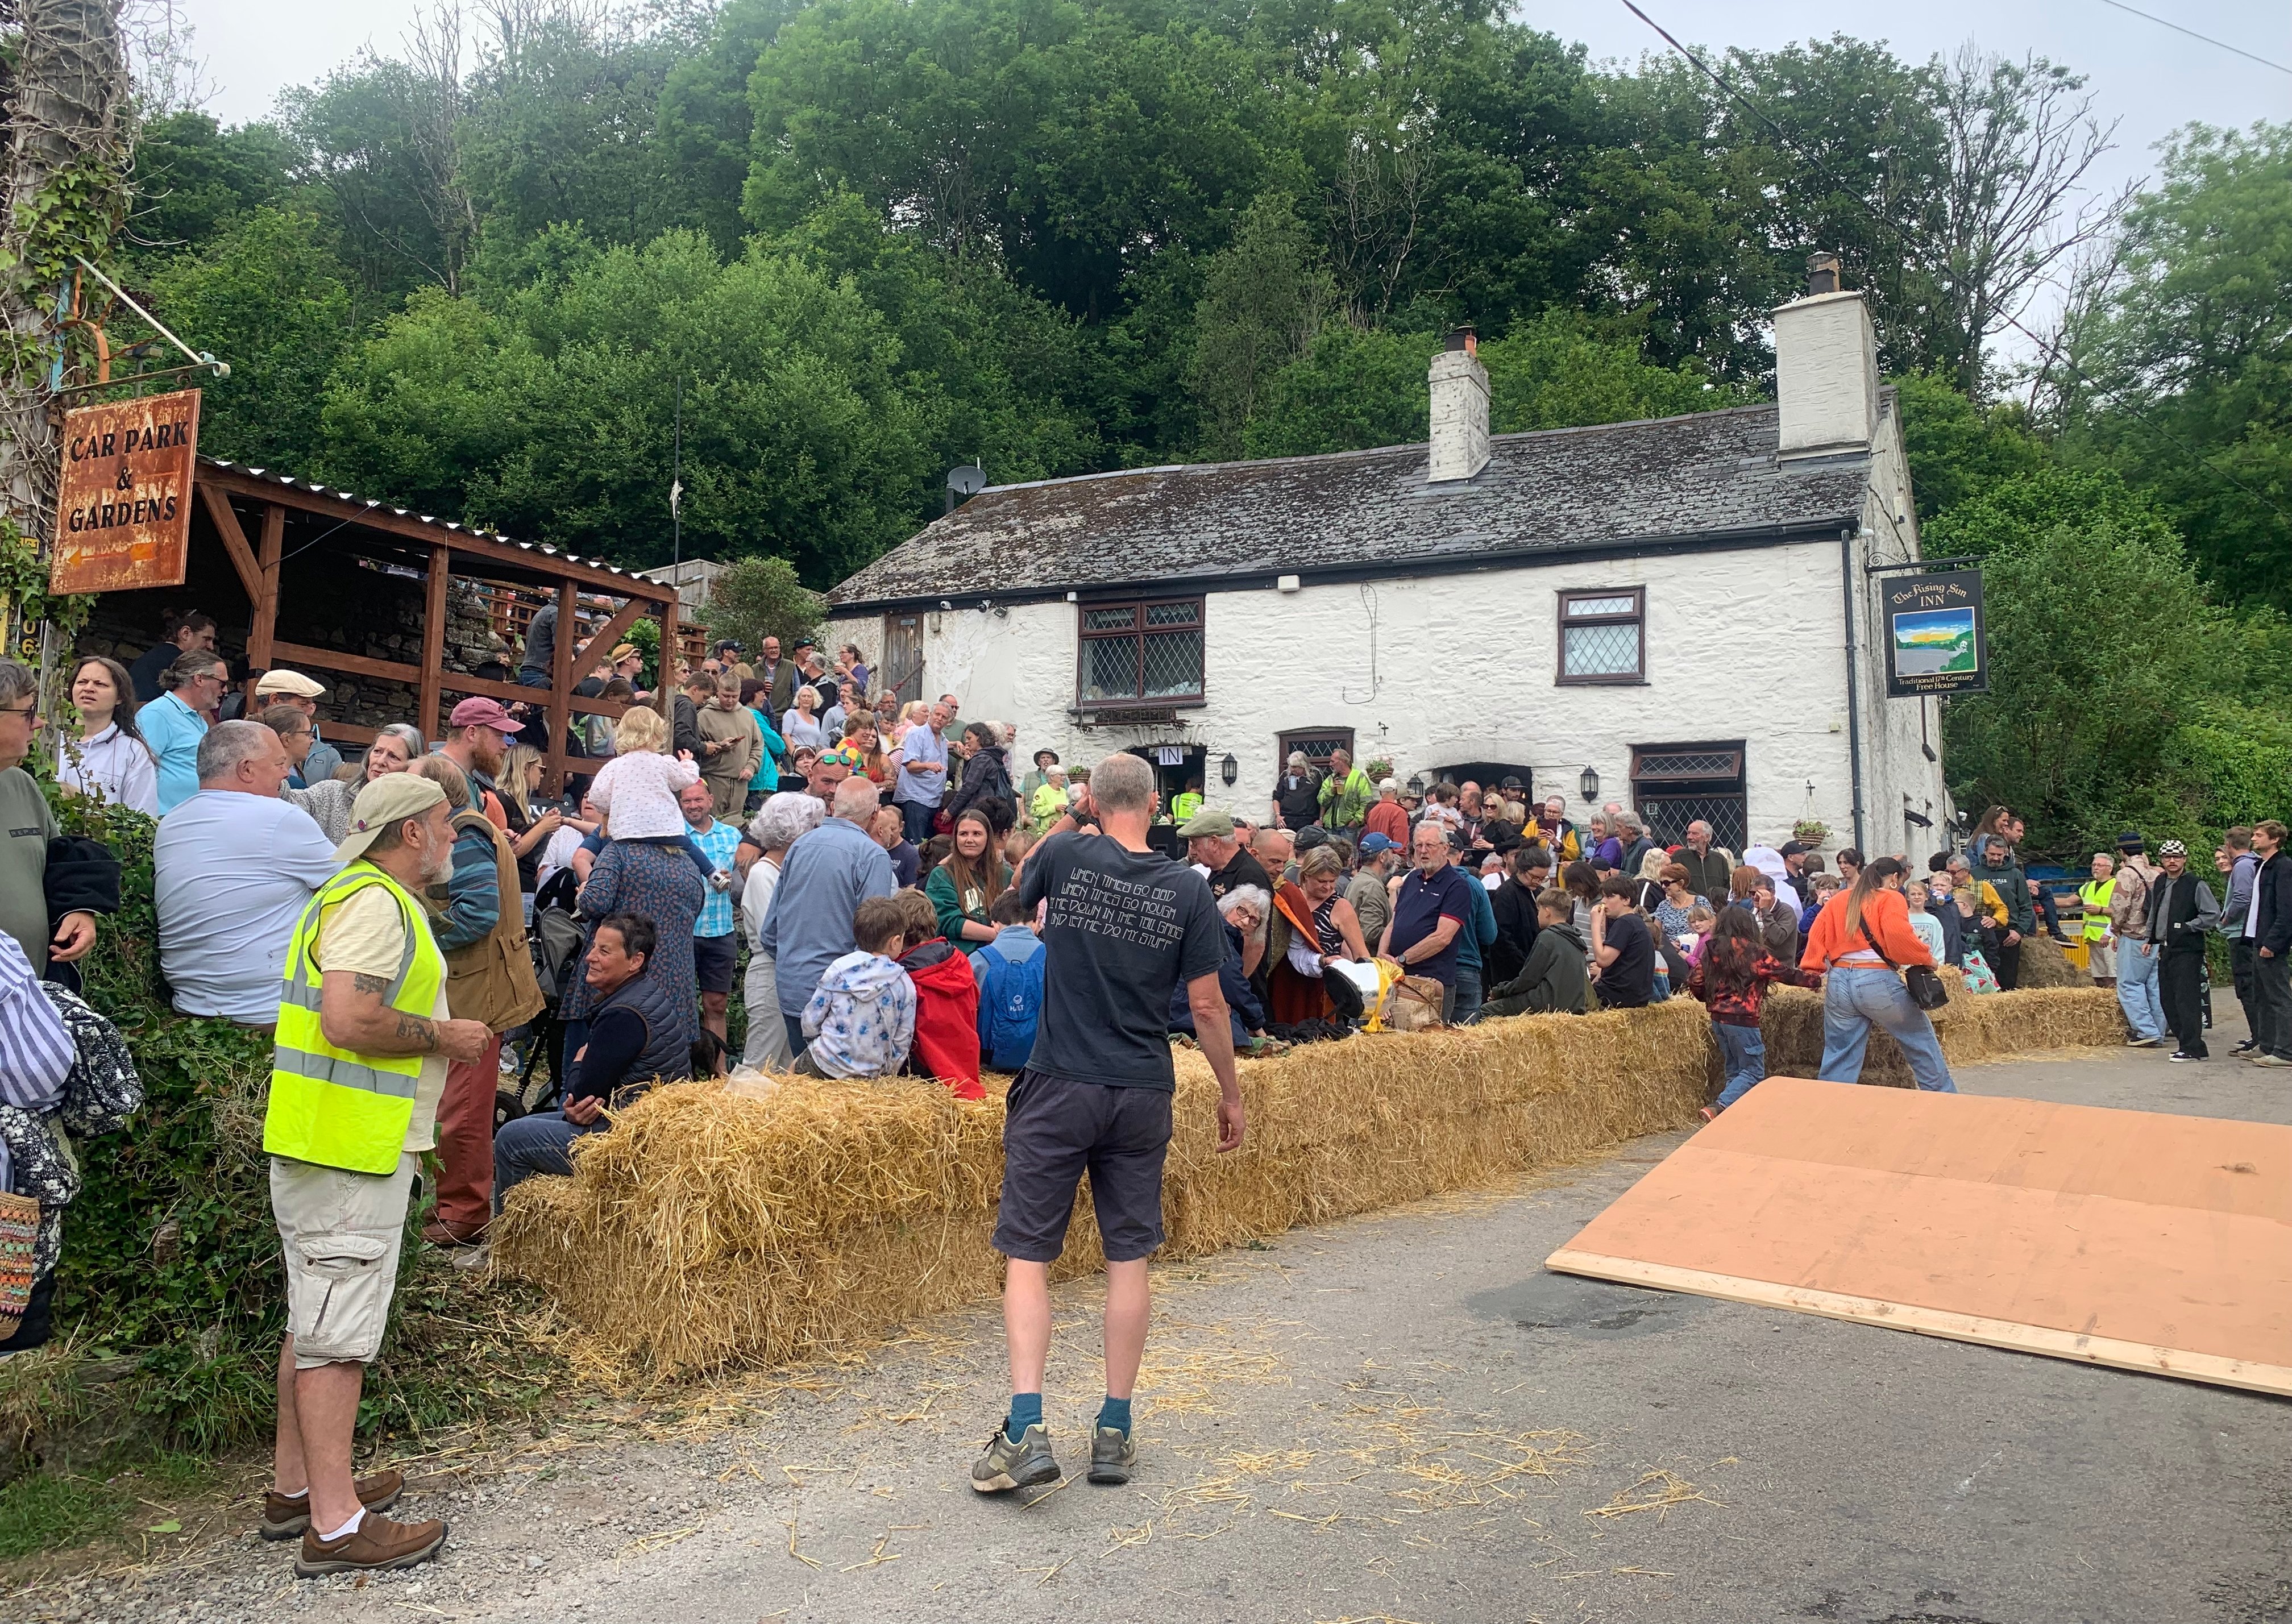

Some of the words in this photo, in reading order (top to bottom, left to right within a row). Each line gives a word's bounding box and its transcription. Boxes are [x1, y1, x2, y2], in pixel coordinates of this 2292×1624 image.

[70, 433, 115, 462] CAR
[124, 421, 188, 454] PARK
[117, 466, 133, 491] &
[69, 496, 177, 533] GARDENS
[1891, 591, 1913, 604] The
[1911, 582, 1945, 597] Rising
[1946, 583, 1967, 598] Sun
[1920, 594, 1944, 607] INN
[1897, 676, 1934, 685] Traditional
[1162, 747, 1180, 763] IN
[1061, 882, 1089, 901] WHEN
[1090, 888, 1121, 906] TIMES
[1122, 897, 1139, 911] GO
[1070, 867, 1100, 887] WHEN
[1102, 874, 1132, 893] TIMES
[1133, 884, 1150, 897] GO
[1055, 898, 1068, 910] ME
[1069, 899, 1102, 920] DOWN
[1102, 907, 1115, 923] IN
[1117, 911, 1137, 926] THE
[1157, 921, 1185, 940] GRAS
[1069, 915, 1084, 928] LET
[1084, 919, 1102, 933] ME
[1103, 923, 1121, 938] DO
[1122, 928, 1139, 942] MY
[1139, 932, 1173, 951] STUFF
